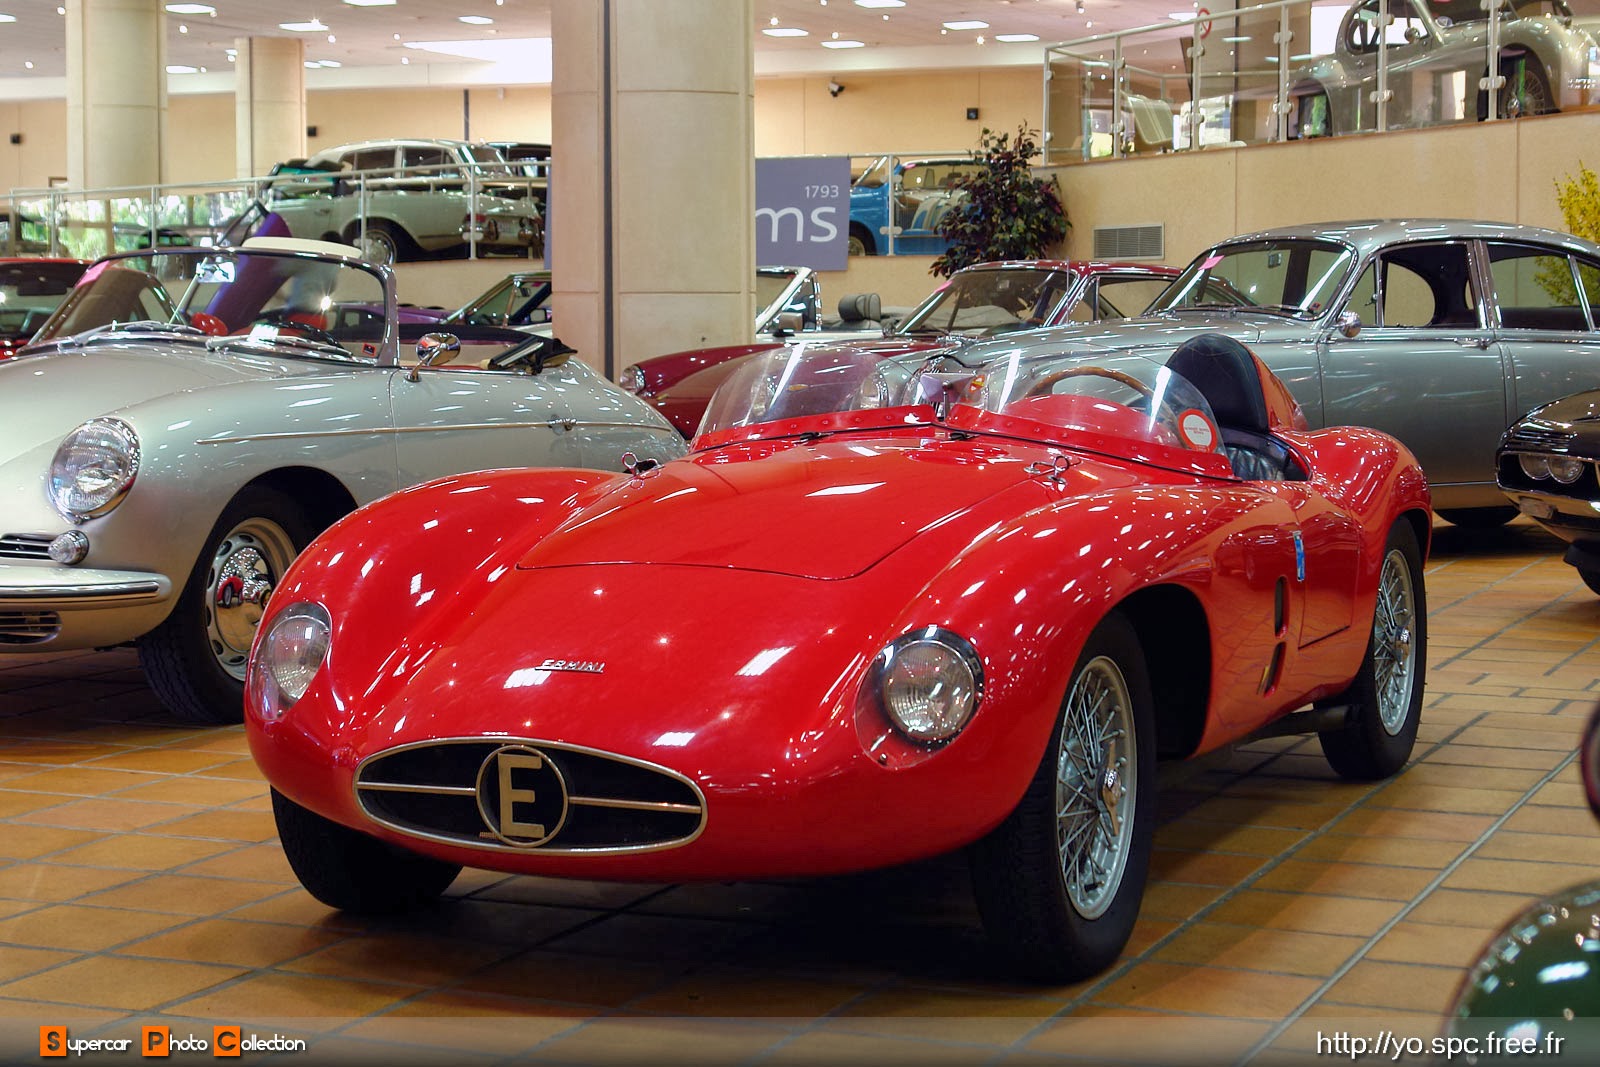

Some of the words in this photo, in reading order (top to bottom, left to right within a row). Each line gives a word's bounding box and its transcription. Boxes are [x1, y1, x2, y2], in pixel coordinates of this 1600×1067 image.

[804, 185, 840, 199] 1793
[540, 659, 606, 674] ERMINI
[497, 752, 546, 839] E
